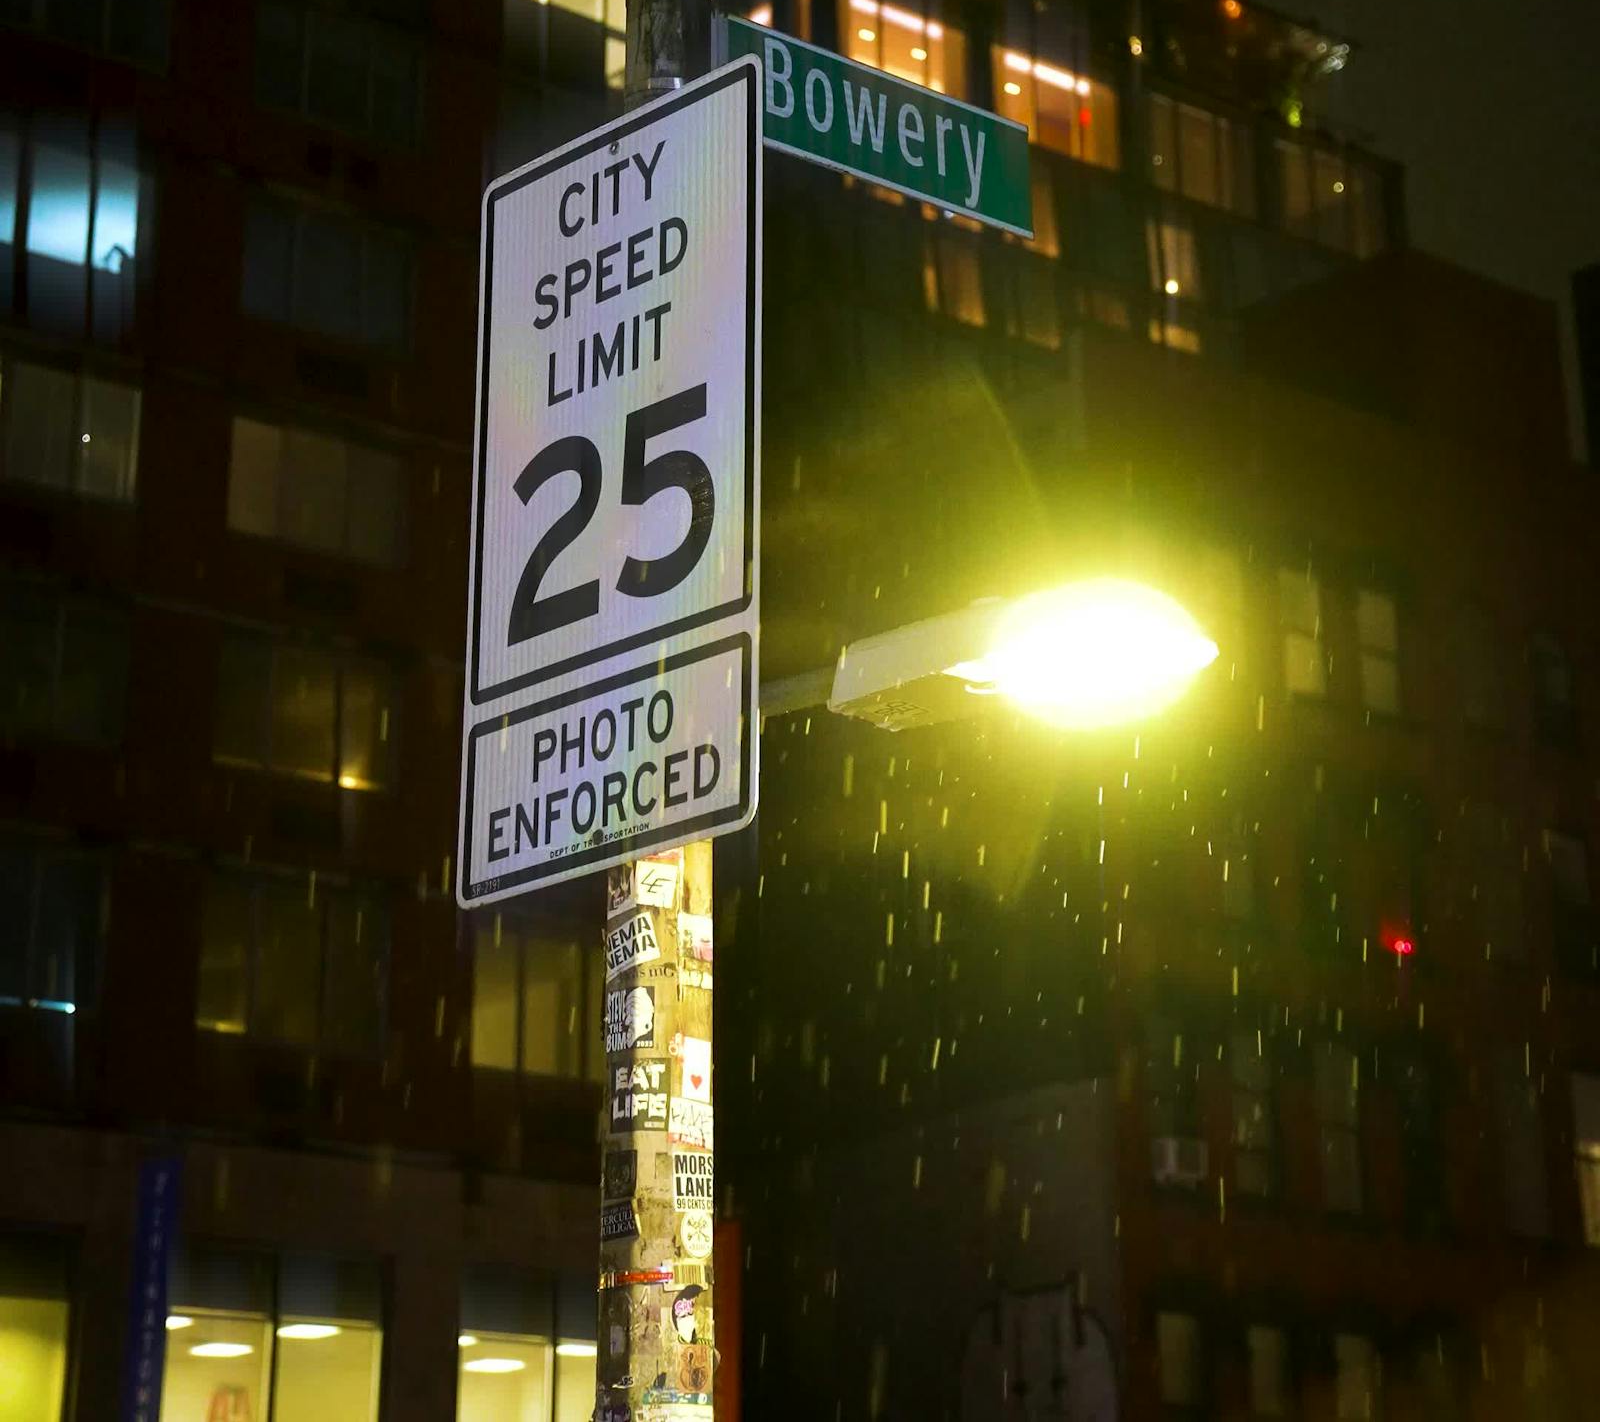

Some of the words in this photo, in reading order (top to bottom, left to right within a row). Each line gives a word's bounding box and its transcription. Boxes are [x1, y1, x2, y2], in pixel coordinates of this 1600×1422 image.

[764, 37, 986, 209] Bowery
[558, 141, 667, 238] CITY
[532, 216, 689, 330] SPEED
[546, 302, 672, 407] LIMIT
[507, 382, 716, 647] 25
[532, 689, 674, 783] PHOTO
[488, 743, 721, 863] ENFORCED
[550, 846, 569, 859] DEPT
[571, 841, 581, 853] OF
[583, 822, 650, 849] TRSPORTATION
[612, 1092, 668, 1123] LIFE
[615, 1063, 666, 1092] EAT
